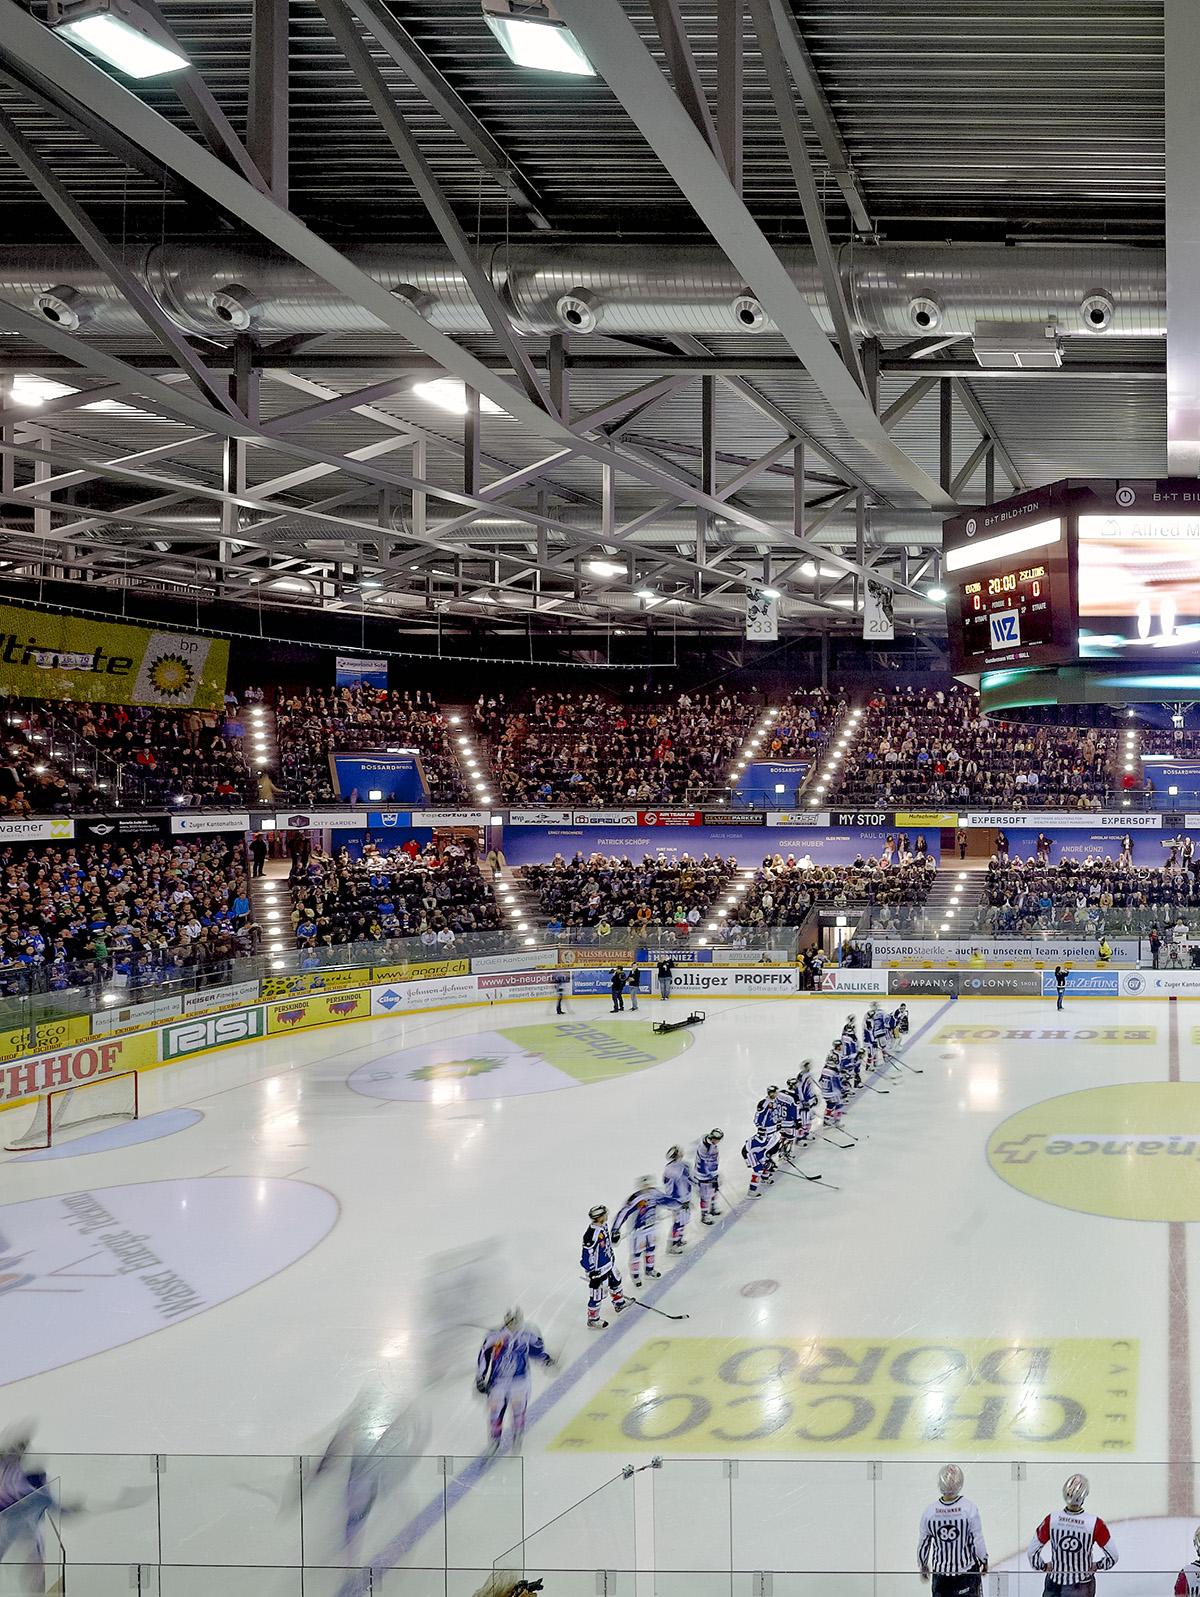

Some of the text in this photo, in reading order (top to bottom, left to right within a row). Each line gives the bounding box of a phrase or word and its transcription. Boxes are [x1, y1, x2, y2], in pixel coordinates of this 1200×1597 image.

[1153, 493, 1178, 501] B+T
[988, 574, 1016, 595] 20:00
[1032, 581, 1040, 597] 0
[973, 595, 980, 610] 0
[753, 621, 772, 634] 33
[180, 638, 198, 652] bp
[839, 814, 886, 826] MY STOP
[971, 816, 1027, 824] EXPERSOFT
[1101, 817, 1157, 825] EXPERSOFT
[981, 947, 989, 955] in
[993, 947, 1031, 956] unserem
[1035, 947, 1059, 956] Team
[1063, 947, 1095, 957] spielen
[735, 974, 792, 984] PROFFIX
[1044, 976, 1118, 988] ZUER ZEITUNG
[1130, 980, 1140, 988] 67
[836, 982, 880, 991] ANLIKER
[186, 994, 215, 1006] KEISER
[326, 994, 362, 1004] PERSKINDOL
[274, 1002, 309, 1013] PERSKINDOL
[115, 1024, 140, 1035] EICHHOF
[169, 1011, 257, 1055] RISI
[944, 1029, 1153, 1040] EICHHOF
[10, 1026, 66, 1045] CHCCO
[75, 1033, 103, 1044] EICHHOF
[33, 1043, 62, 1054] EICHHOF
[620, 1393, 1088, 1443] CHICCO
[938, 1527, 957, 1539] 86
[1061, 1538, 1079, 1550] 69
